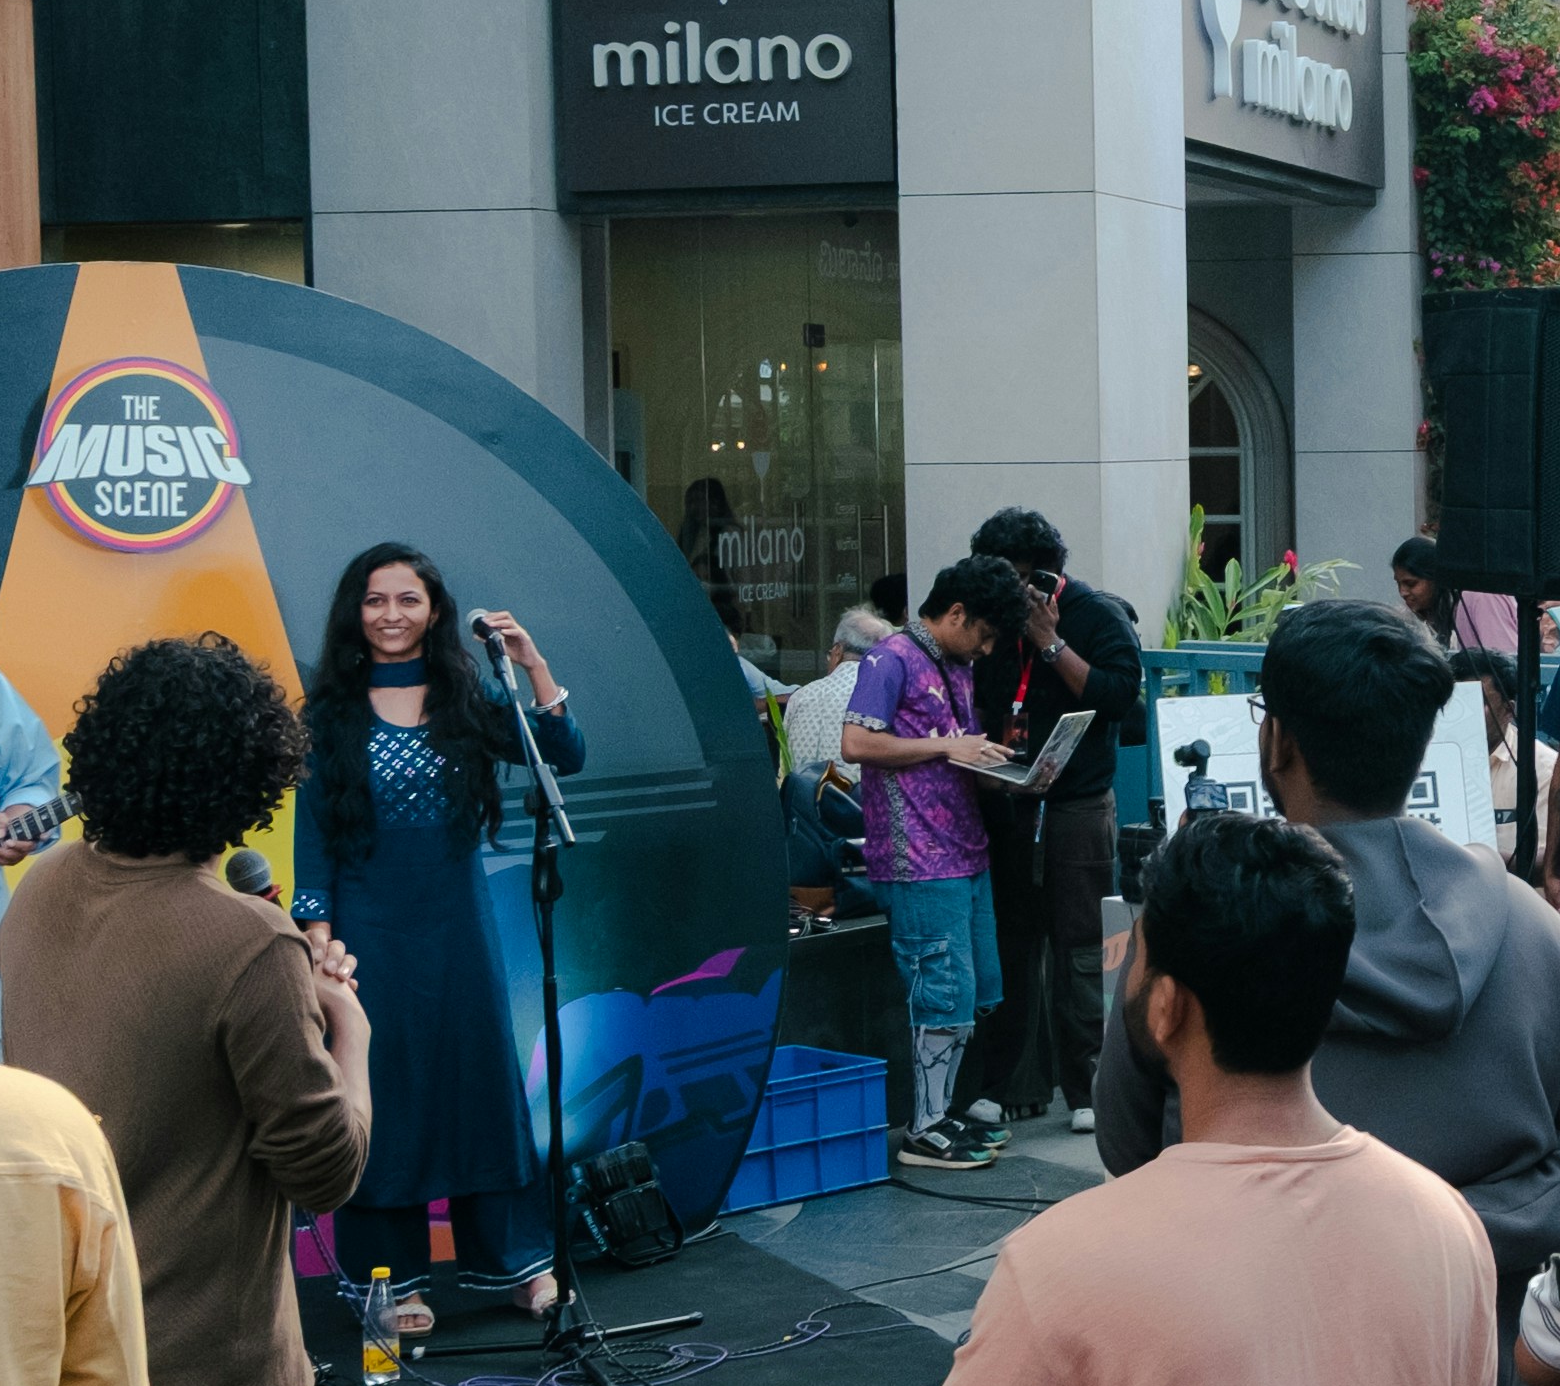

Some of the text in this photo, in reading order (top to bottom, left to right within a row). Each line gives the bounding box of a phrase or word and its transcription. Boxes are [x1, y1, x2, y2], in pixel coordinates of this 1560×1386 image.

[592, 20, 853, 89] milano
[1242, 20, 1353, 132] milano
[652, 100, 801, 127] ICE CREAM
[121, 395, 160, 420] THE
[26, 423, 252, 486] MUSIC
[94, 480, 188, 517] SCENE
[718, 515, 805, 569] milano
